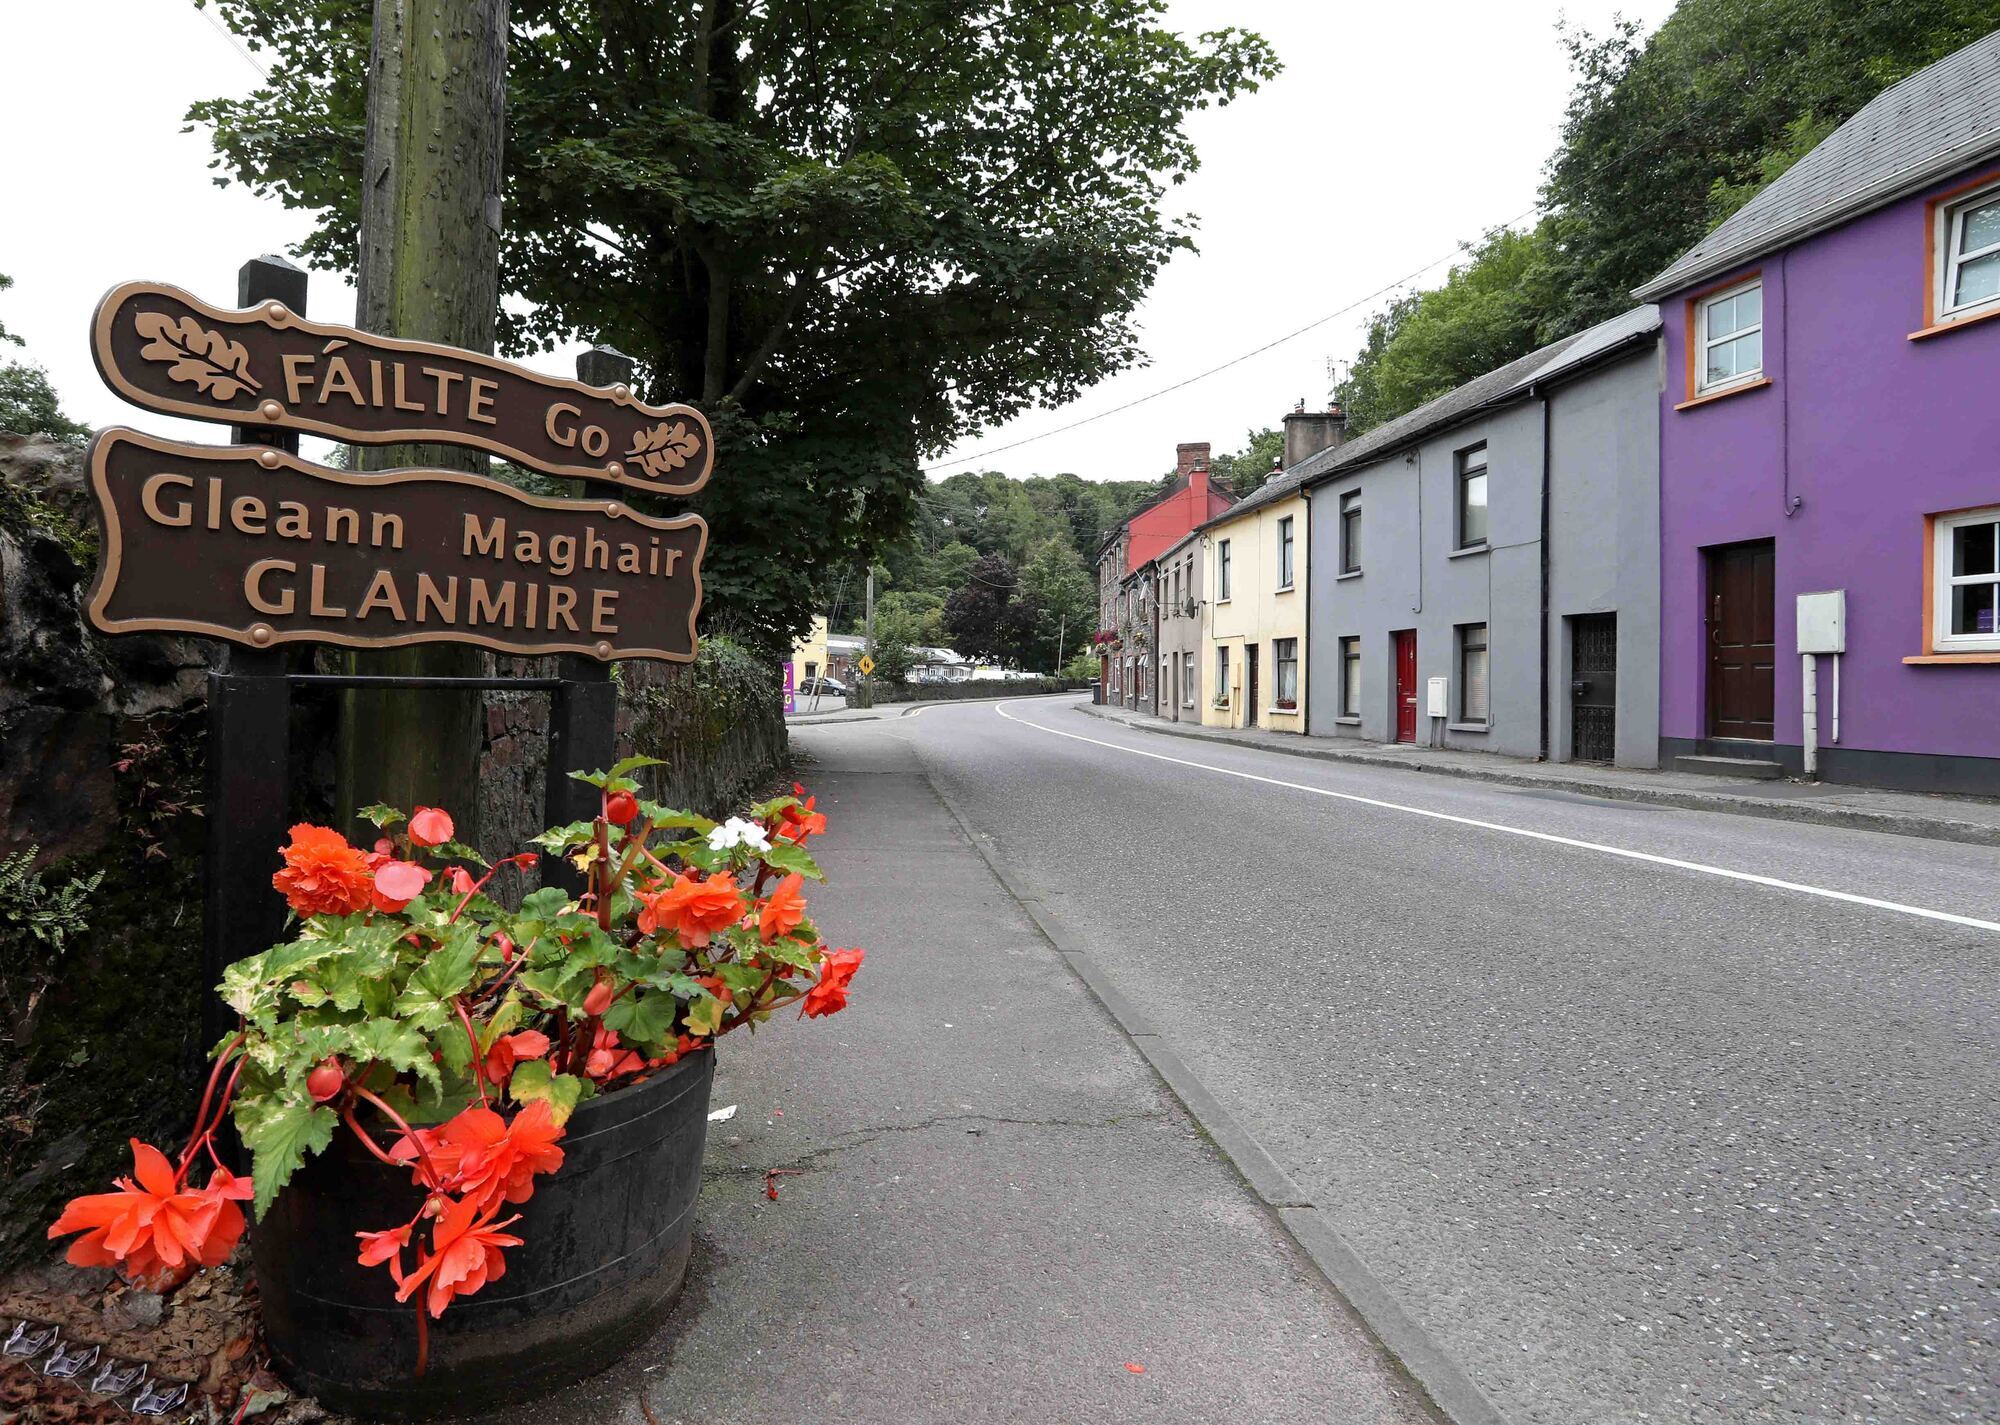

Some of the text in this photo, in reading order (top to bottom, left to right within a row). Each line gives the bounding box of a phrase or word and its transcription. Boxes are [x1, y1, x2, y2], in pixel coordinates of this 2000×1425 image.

[281, 340, 610, 456] FÁILTE Go
[140, 472, 683, 578] Gleann Maghair
[243, 558, 620, 634] GLANMIRE
